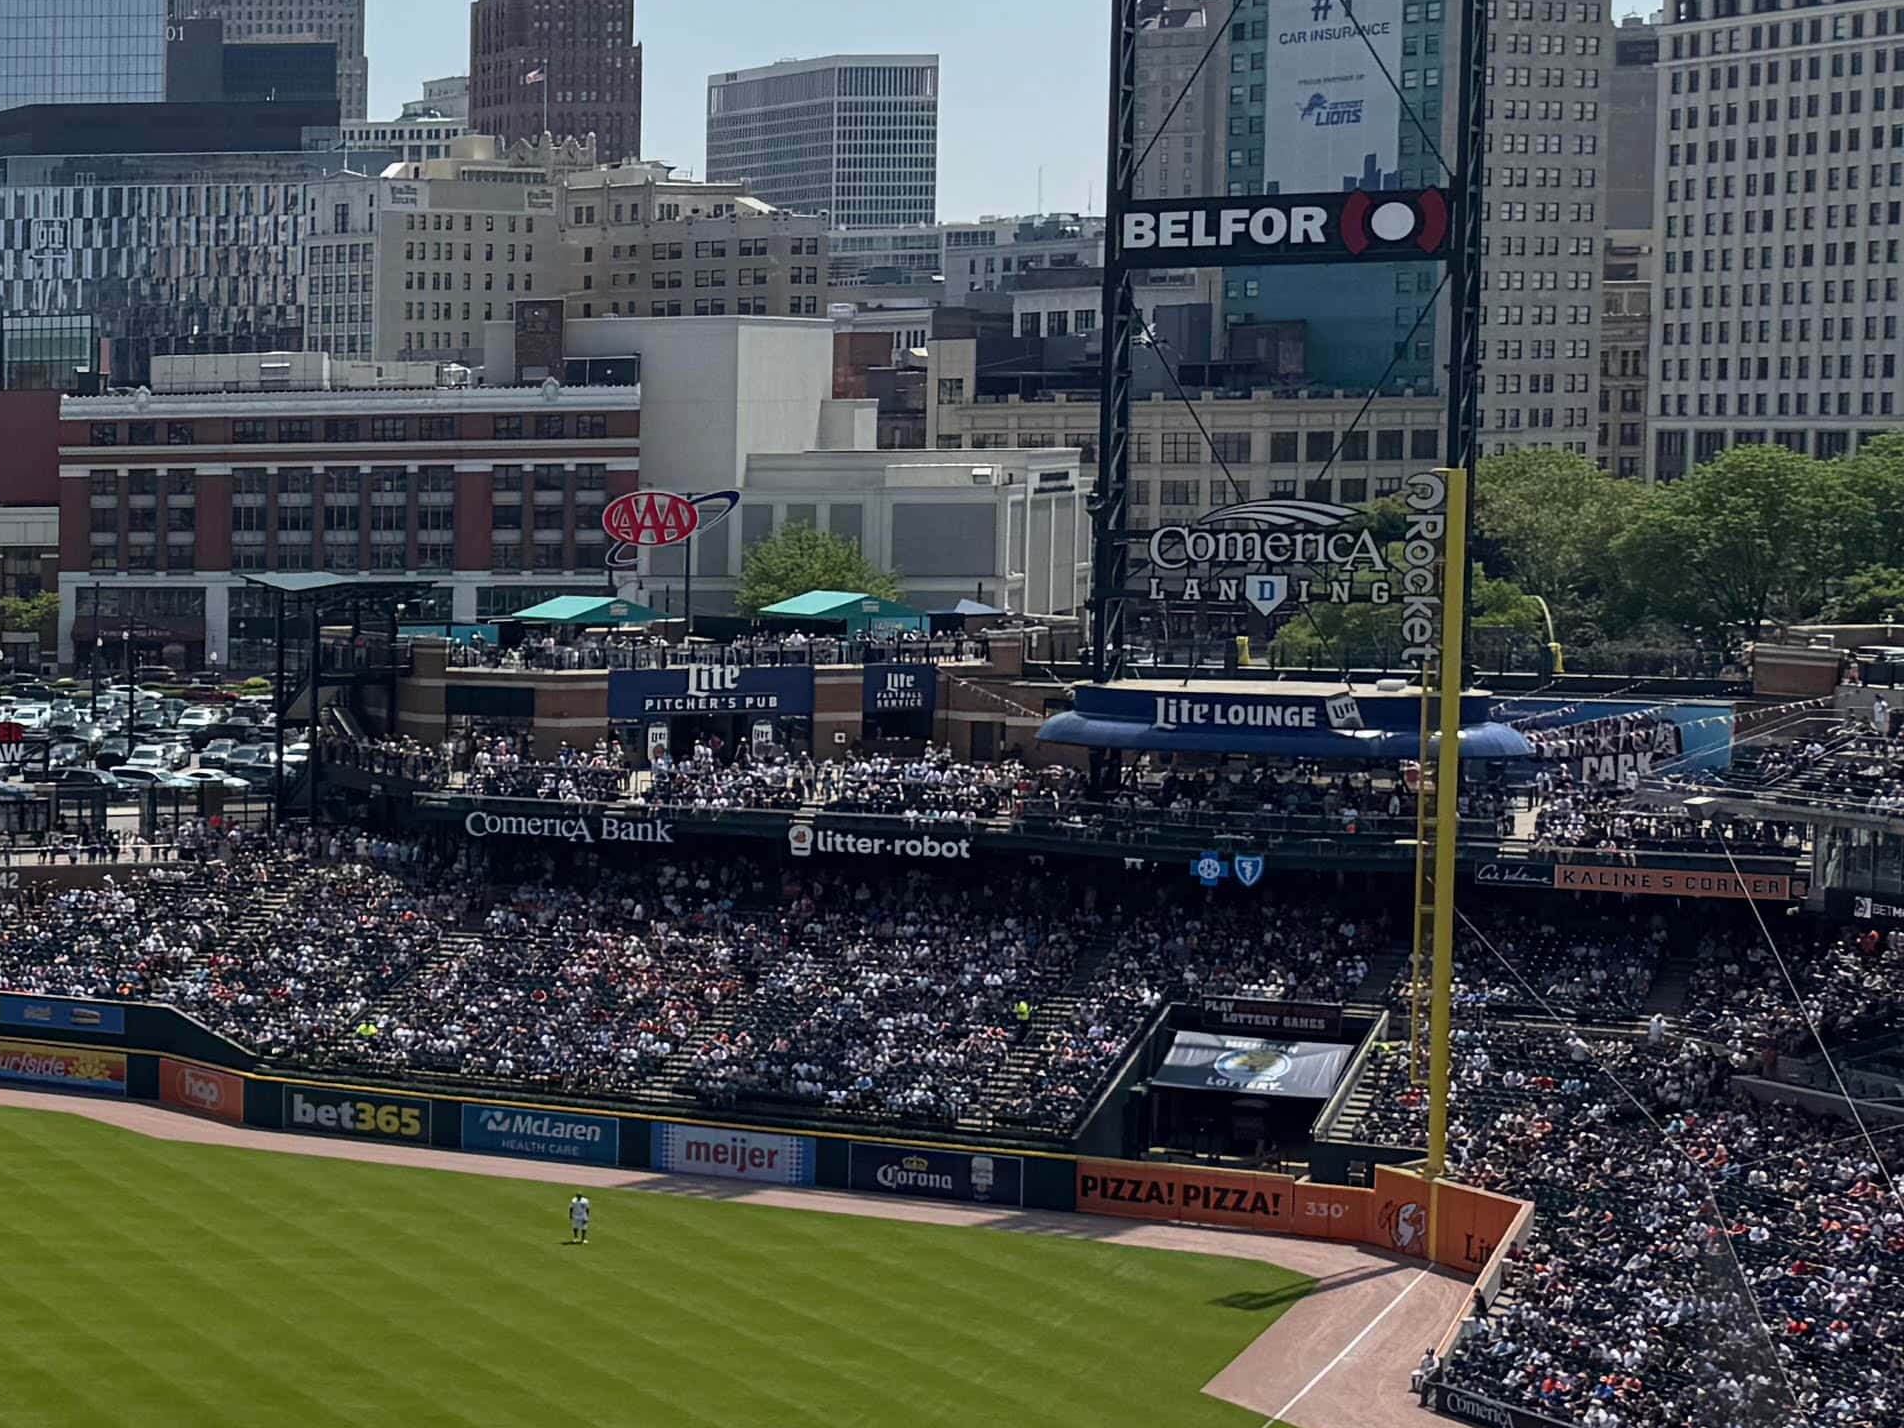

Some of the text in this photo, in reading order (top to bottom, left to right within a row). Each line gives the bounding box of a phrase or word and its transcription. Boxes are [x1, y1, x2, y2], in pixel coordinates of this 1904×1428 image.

[1279, 22, 1390, 44] CAR INSURANCE
[1315, 108, 1362, 126] LIONS
[1123, 206, 1328, 249] BELFOR
[1149, 578, 1389, 603] LANDING
[1401, 514, 1444, 662] Rocket
[687, 663, 740, 697] Lite
[644, 696, 778, 711] PITCHER'S PUB
[1153, 697, 1316, 731] Lite LOUNGE
[600, 817, 674, 843] Bank
[1686, 876, 1780, 893] CORNER
[1222, 1013, 1279, 1027] LOTTERY
[293, 1093, 422, 1137] bet365
[512, 1115, 601, 1142] McLaren
[501, 1140, 579, 1157] HEALTH CARE
[685, 1136, 778, 1172] meijer
[876, 1163, 952, 1191] Corona
[1081, 1174, 1281, 1216] PIZZA! PIZZA!
[1304, 1201, 1350, 1219] 330'
